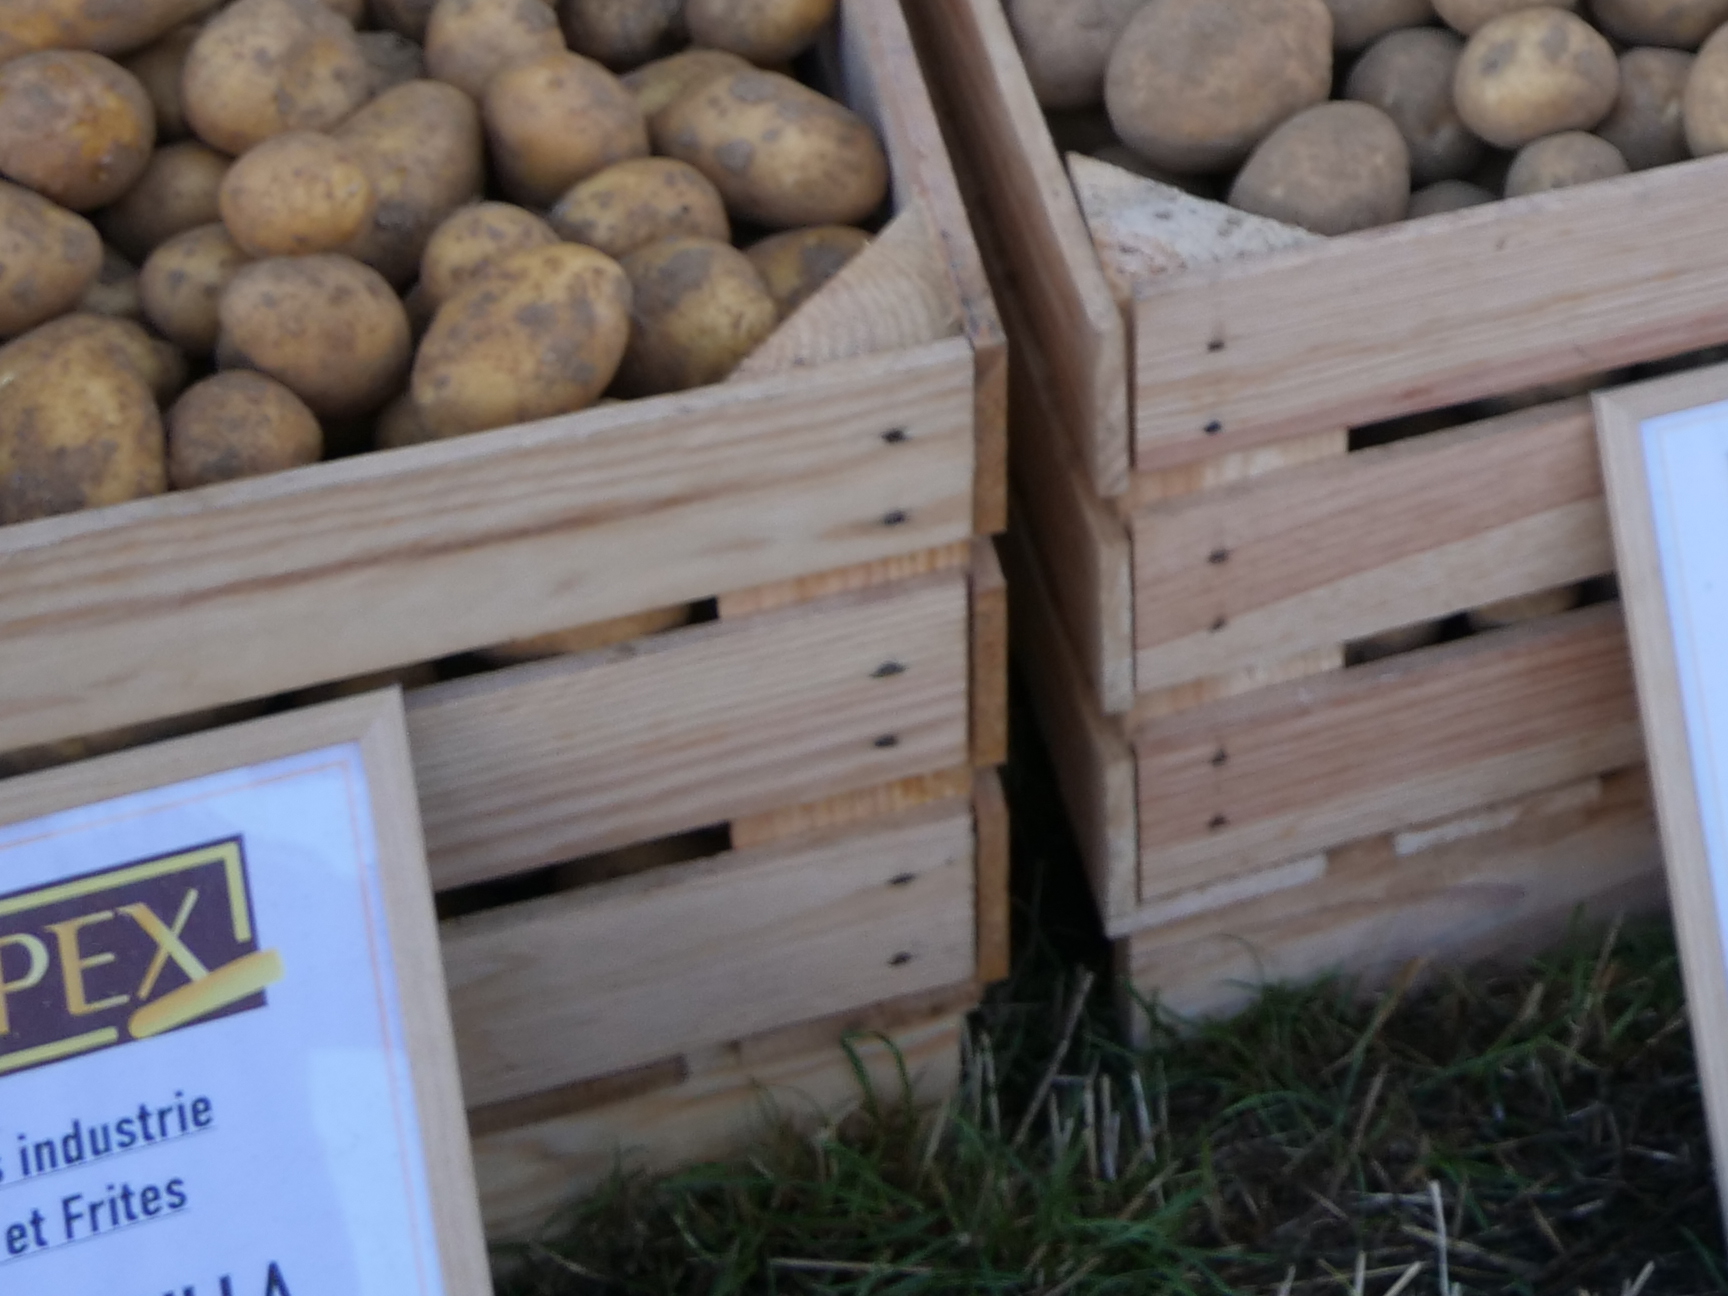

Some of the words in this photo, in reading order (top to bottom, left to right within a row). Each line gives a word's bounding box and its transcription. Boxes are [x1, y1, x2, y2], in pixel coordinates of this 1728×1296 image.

[18, 1090, 214, 1178] industrie
[5, 1207, 48, 1255] et
[61, 1175, 188, 1240] Frites
